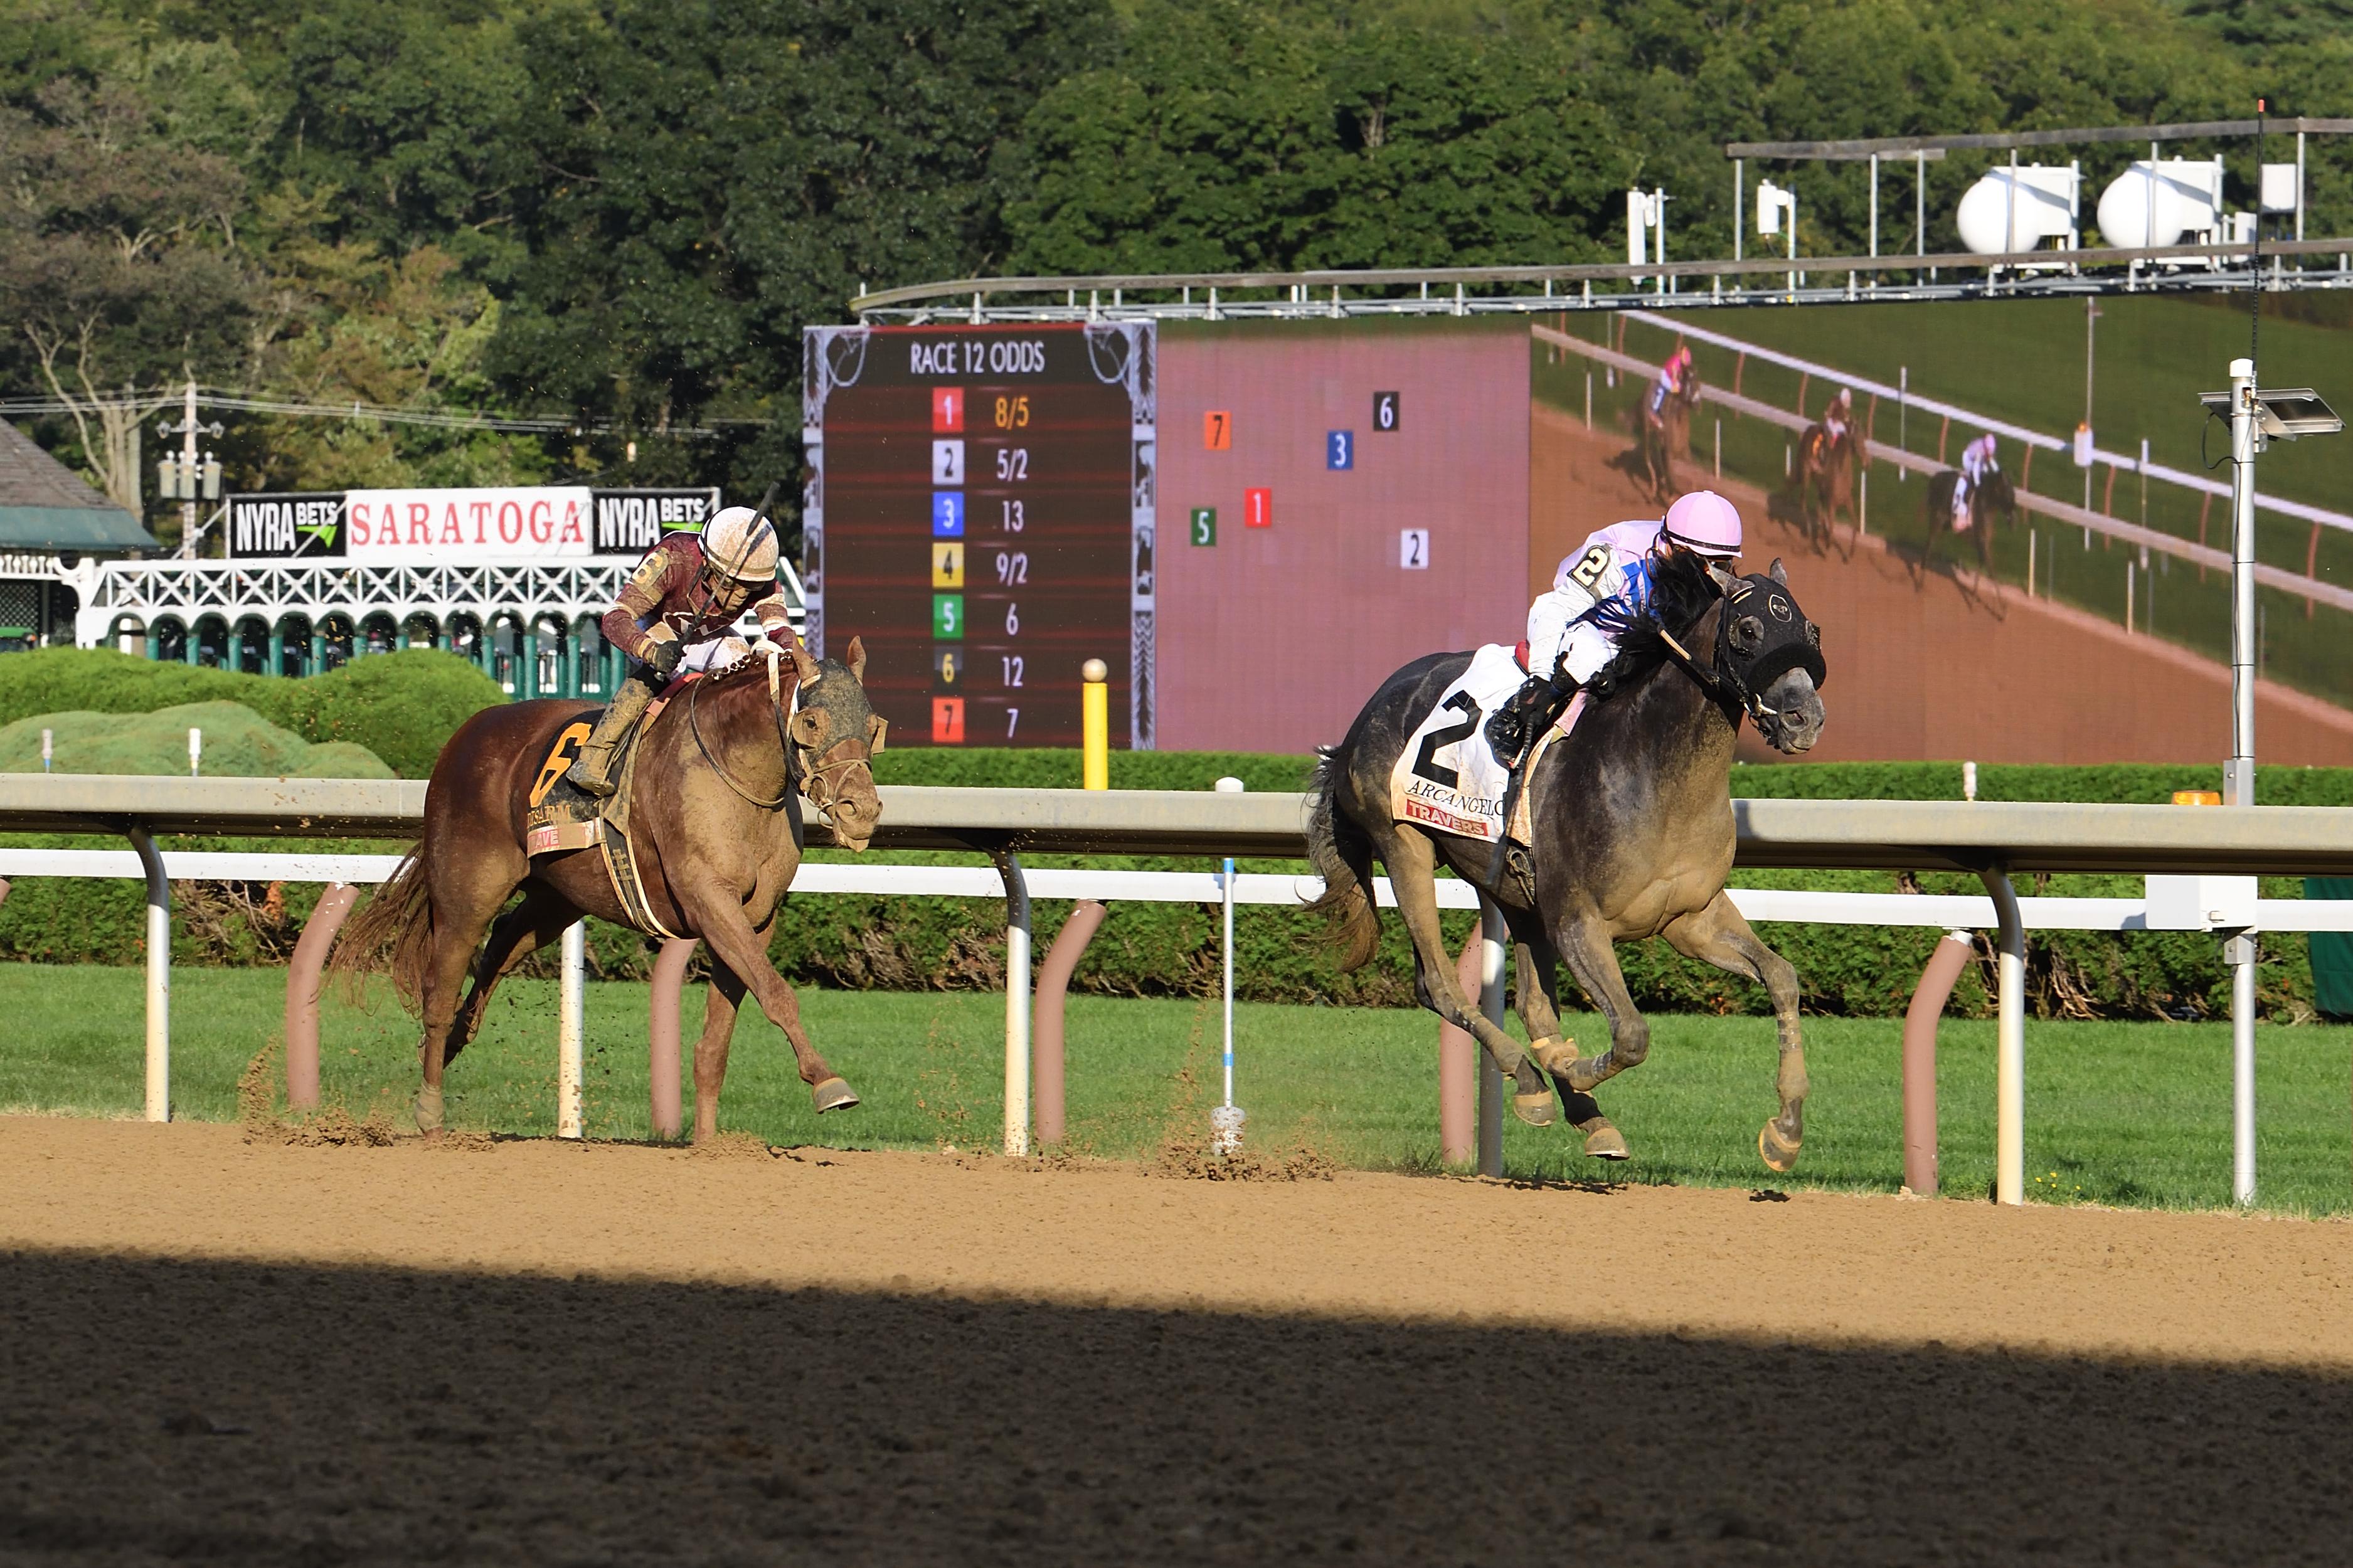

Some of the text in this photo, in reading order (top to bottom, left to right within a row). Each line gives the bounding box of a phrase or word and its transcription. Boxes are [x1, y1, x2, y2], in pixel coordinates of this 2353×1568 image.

[910, 341, 1046, 373] RACE 12 ODDS
[943, 396, 1029, 430] 1 8/5
[1379, 396, 1393, 428] 6
[1213, 415, 1223, 447] 7
[943, 448, 1028, 482] 2 5/2
[1334, 433, 1346, 467] 3
[351, 499, 585, 547] SARATOGA
[599, 497, 705, 548] NYRA BETS
[943, 498, 1024, 532] 3 13
[1253, 492, 1262, 524] 1
[236, 501, 339, 551] NYRA BETS
[1198, 511, 1209, 544] 5
[1410, 533, 1420, 566] 2
[632, 552, 663, 584] 6
[943, 550, 1028, 586] 4 9/2
[1572, 548, 1608, 586] 2
[943, 602, 1019, 636] 5 6
[942, 653, 1024, 687] 6 12
[944, 704, 1019, 738] 7 7
[1412, 689, 1483, 790] 2
[529, 723, 592, 808] 6
[1410, 802, 1485, 835] TRAVERS
